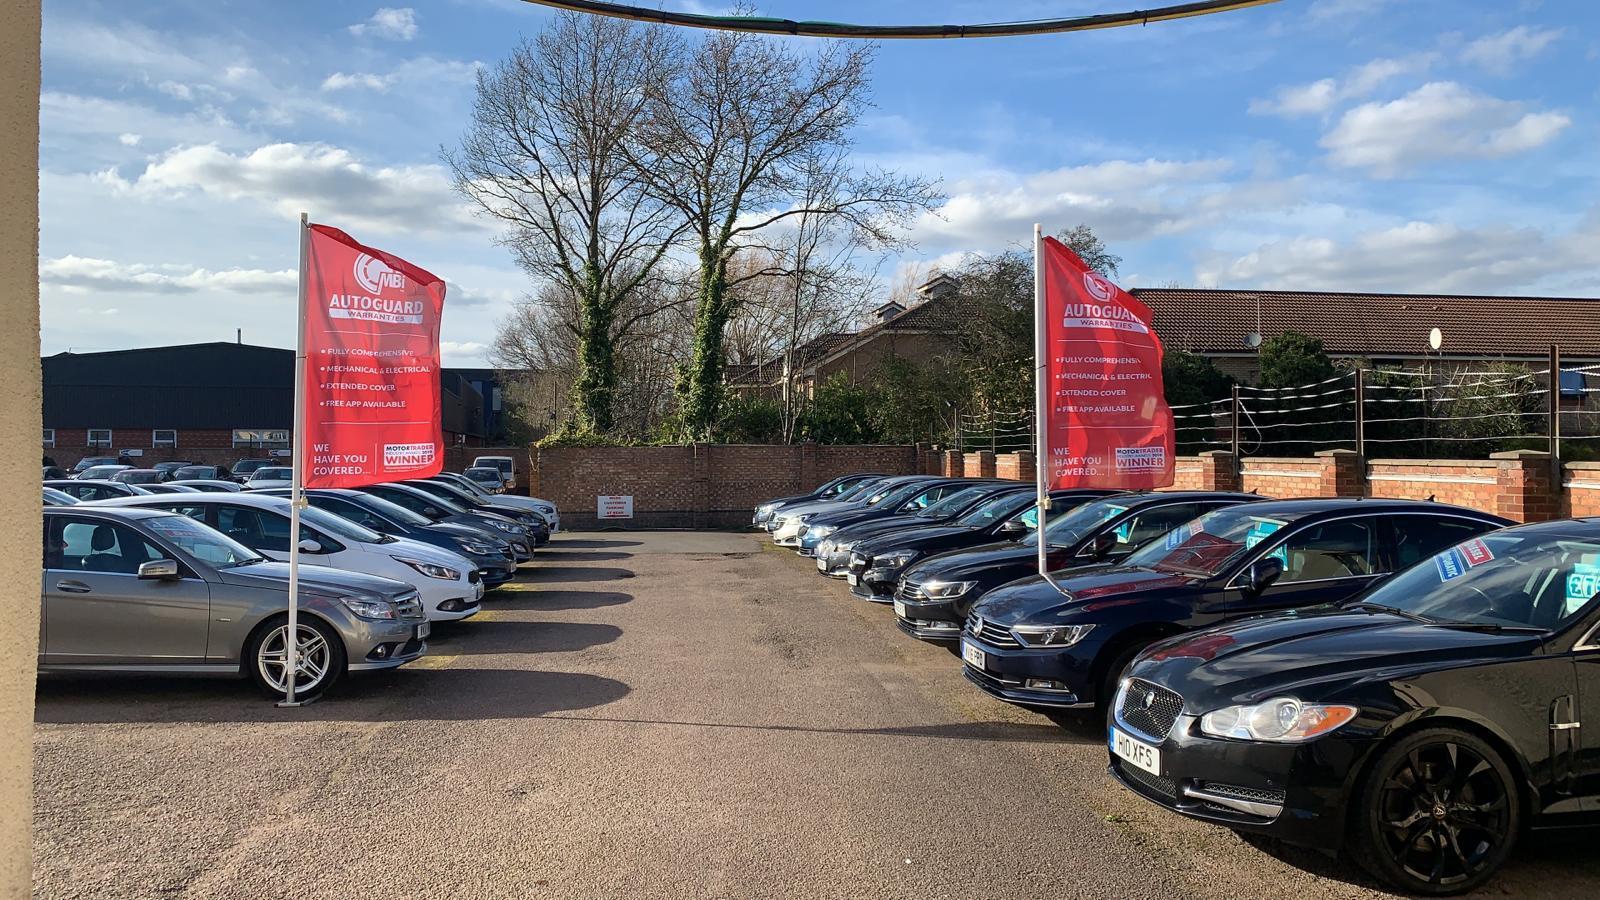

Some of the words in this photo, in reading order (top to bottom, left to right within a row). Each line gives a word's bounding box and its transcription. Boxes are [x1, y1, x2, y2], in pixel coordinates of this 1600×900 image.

[330, 294, 424, 314] AUTOGUARD
[347, 311, 405, 322] WARRANTIES
[1081, 319, 1133, 329] WARRANTIES
[326, 365, 379, 374] MECHANICAL
[385, 366, 431, 374] ELECTRICAL
[1061, 373, 1109, 381] MECHANICAL
[326, 382, 368, 391] EXTENDED
[1100, 389, 1127, 397] COVER
[326, 400, 344, 408] FREE
[345, 400, 362, 408] APP
[362, 400, 407, 408] AVAILABLE
[1062, 405, 1078, 413] FREE
[1094, 405, 1136, 413] AVAILABLE
[313, 443, 329, 452] WE
[1053, 447, 1070, 455] WE
[313, 455, 341, 464] HAVE
[343, 454, 368, 463] YOU
[385, 455, 434, 465] WINNER
[1054, 457, 1079, 467] HAVE
[1080, 456, 1102, 465] YOU
[1116, 458, 1164, 467] WINNER
[313, 466, 371, 475] COVERED...
[1055, 467, 1105, 478] COVERED...
[1132, 741, 1153, 768] XFS
